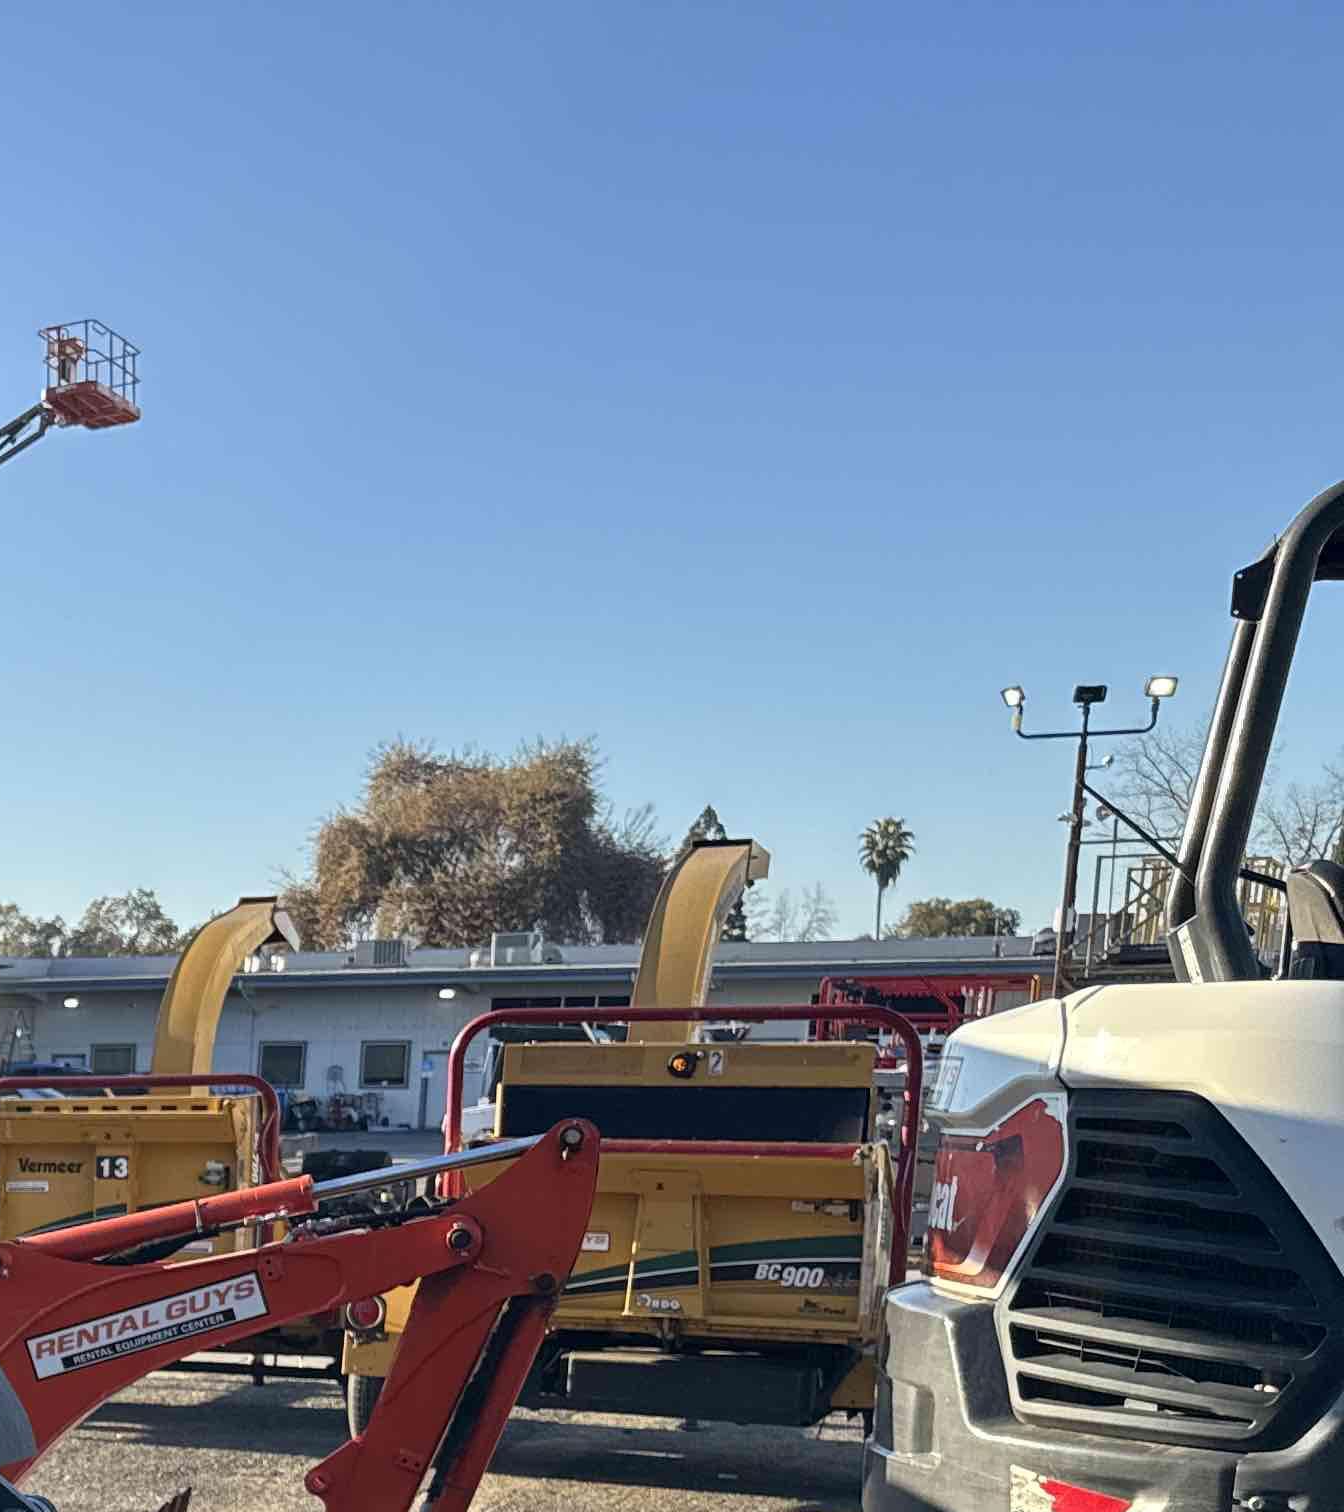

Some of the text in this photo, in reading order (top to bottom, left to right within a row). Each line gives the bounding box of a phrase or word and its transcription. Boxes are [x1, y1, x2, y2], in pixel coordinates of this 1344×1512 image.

[18, 1157, 83, 1175] Vermeer
[99, 1157, 128, 1178] 13
[928, 1176, 958, 1231] cat
[34, 1279, 255, 1359] RENTAL GUYS
[73, 1314, 225, 1365] RENTAL EQUIPMENT CENTER
